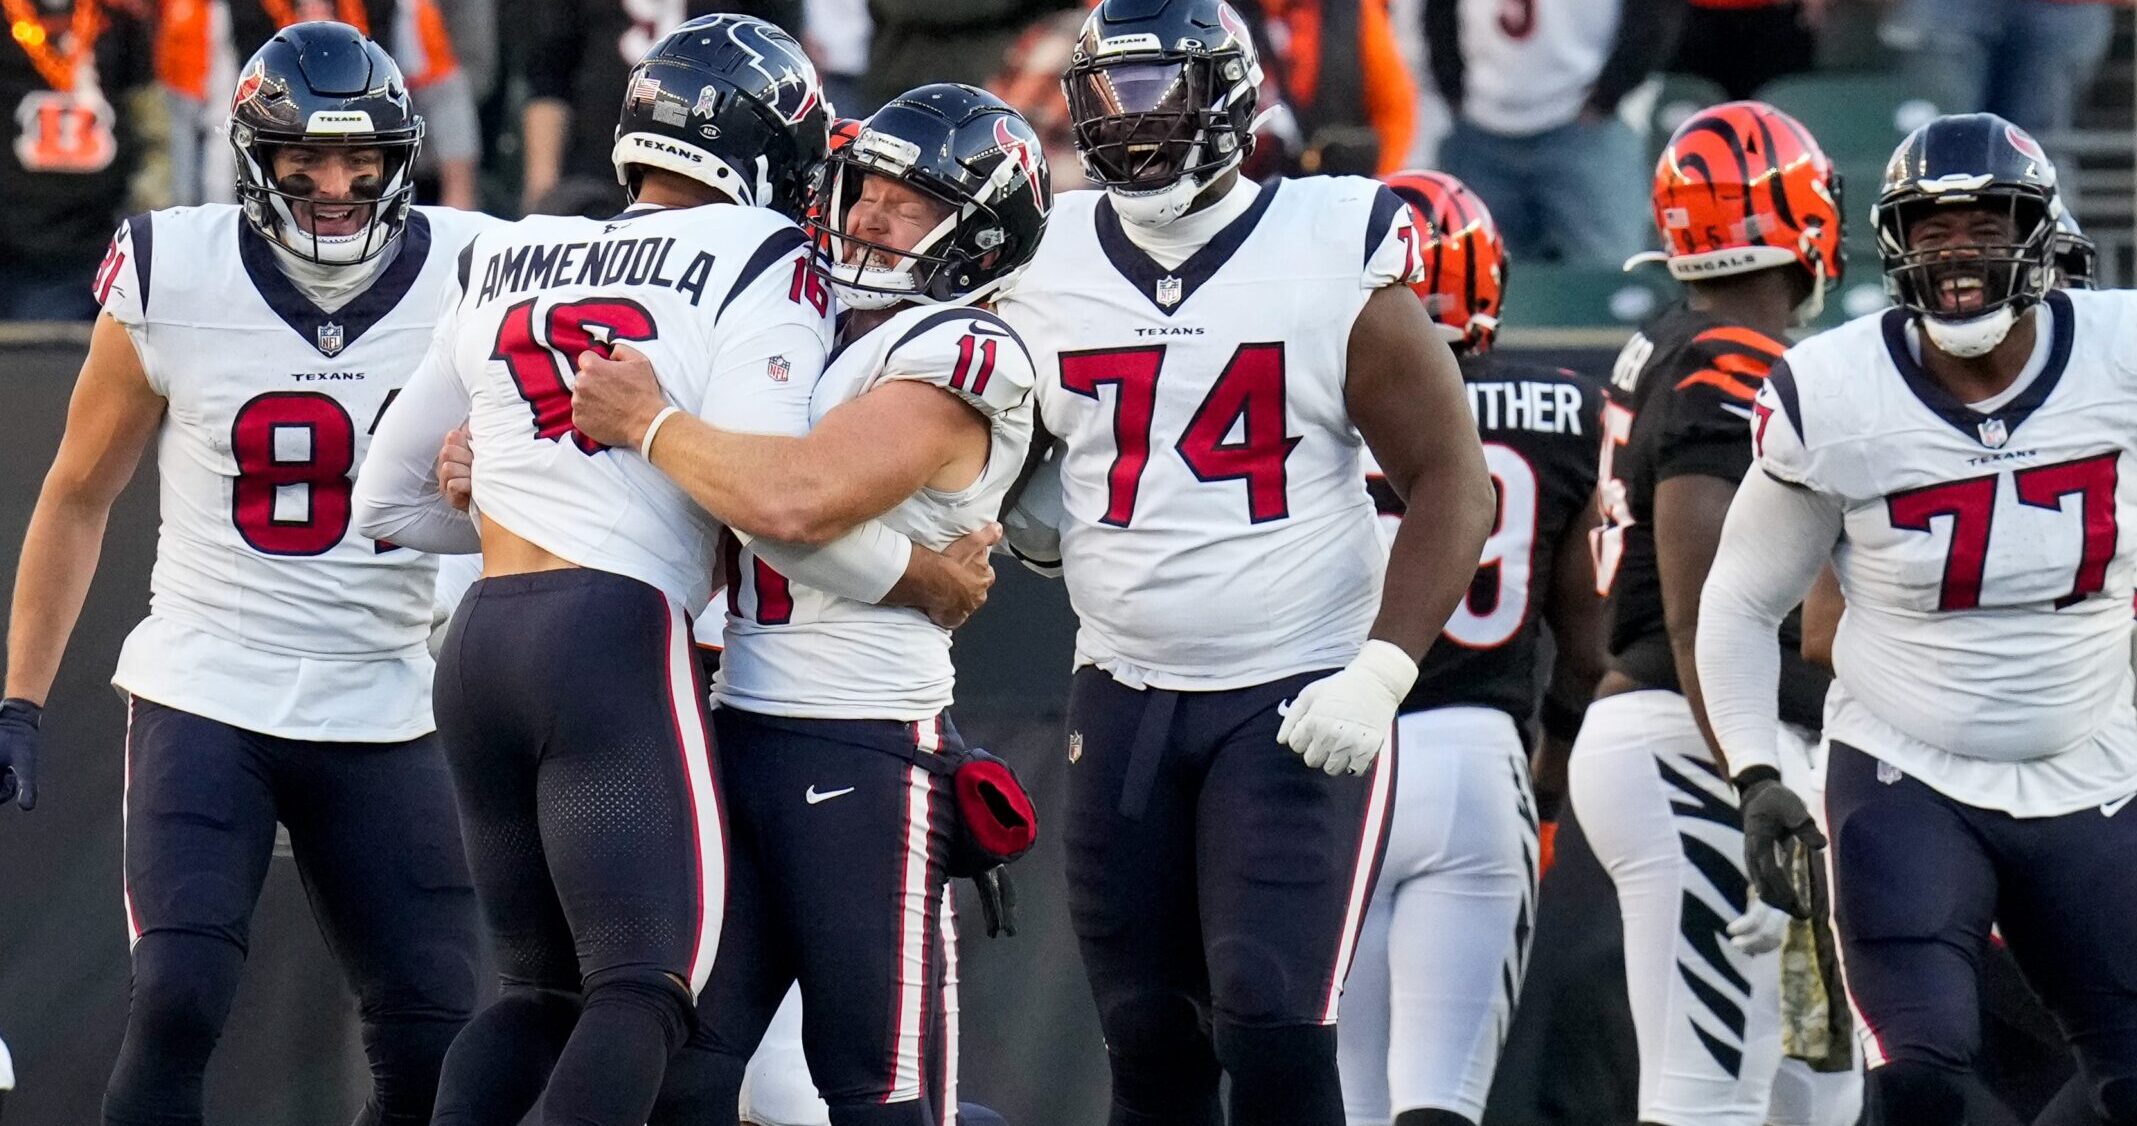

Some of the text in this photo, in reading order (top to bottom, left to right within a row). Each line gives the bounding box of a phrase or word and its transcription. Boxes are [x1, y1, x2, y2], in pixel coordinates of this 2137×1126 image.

[1106, 37, 1148, 46] TEXANS
[318, 115, 363, 123] TEXANS
[633, 137, 704, 163] TEXANS
[476, 236, 716, 310] AMMENDOLA
[1134, 327, 1206, 337] TEXANS
[769, 363, 788, 382] NFL
[948, 333, 997, 397] 11
[290, 372, 366, 382] TEXANS
[1058, 341, 1304, 528] 74
[1965, 449, 2038, 467] TEXANS
[1885, 449, 2122, 612] 77
